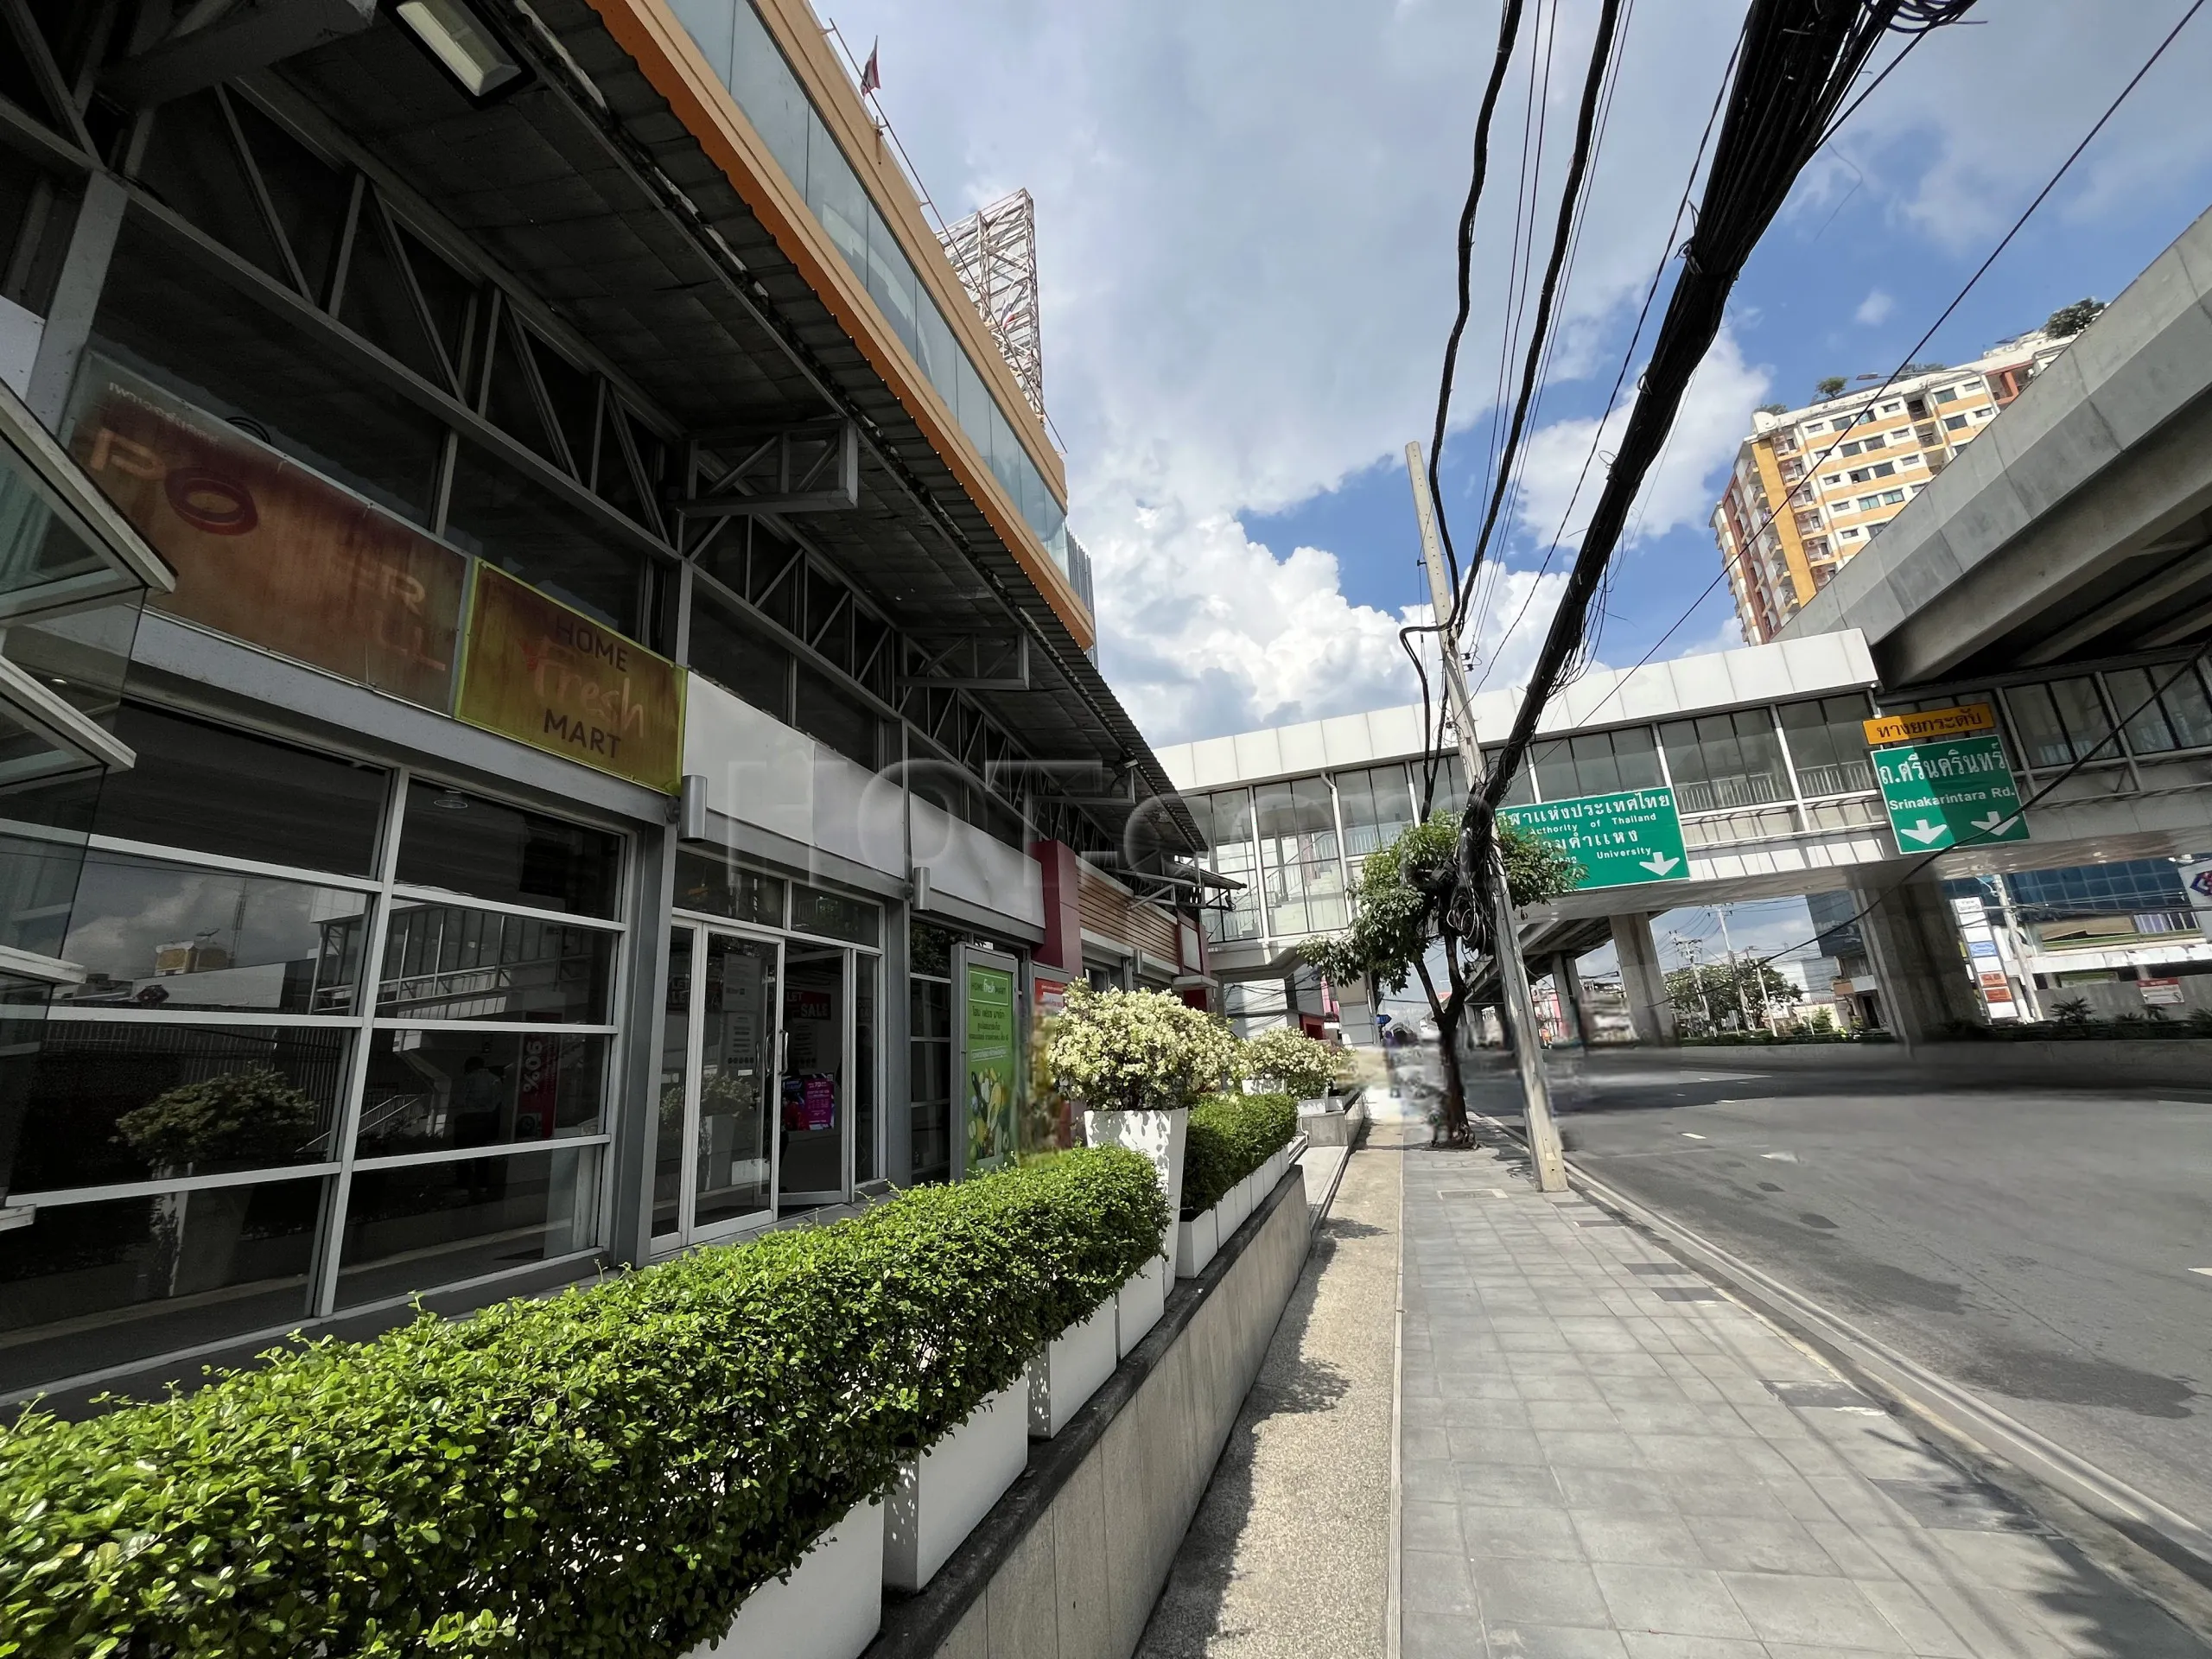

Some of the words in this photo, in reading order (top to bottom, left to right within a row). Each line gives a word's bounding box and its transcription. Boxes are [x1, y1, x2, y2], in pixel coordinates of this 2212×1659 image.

[555, 615, 629, 673] HOME
[543, 708, 622, 759] MART
[1876, 708, 1983, 738] ทางยกระดับ
[1878, 741, 2006, 785] ถ.ศรีนครินทร์
[1888, 791, 1986, 810] Srinakarintara
[1990, 786, 2016, 799] Rd.
[1589, 819, 1601, 828] of
[1611, 812, 1657, 825] Thailand
[1596, 847, 1651, 860] University
[800, 1002, 830, 1018] SALE
